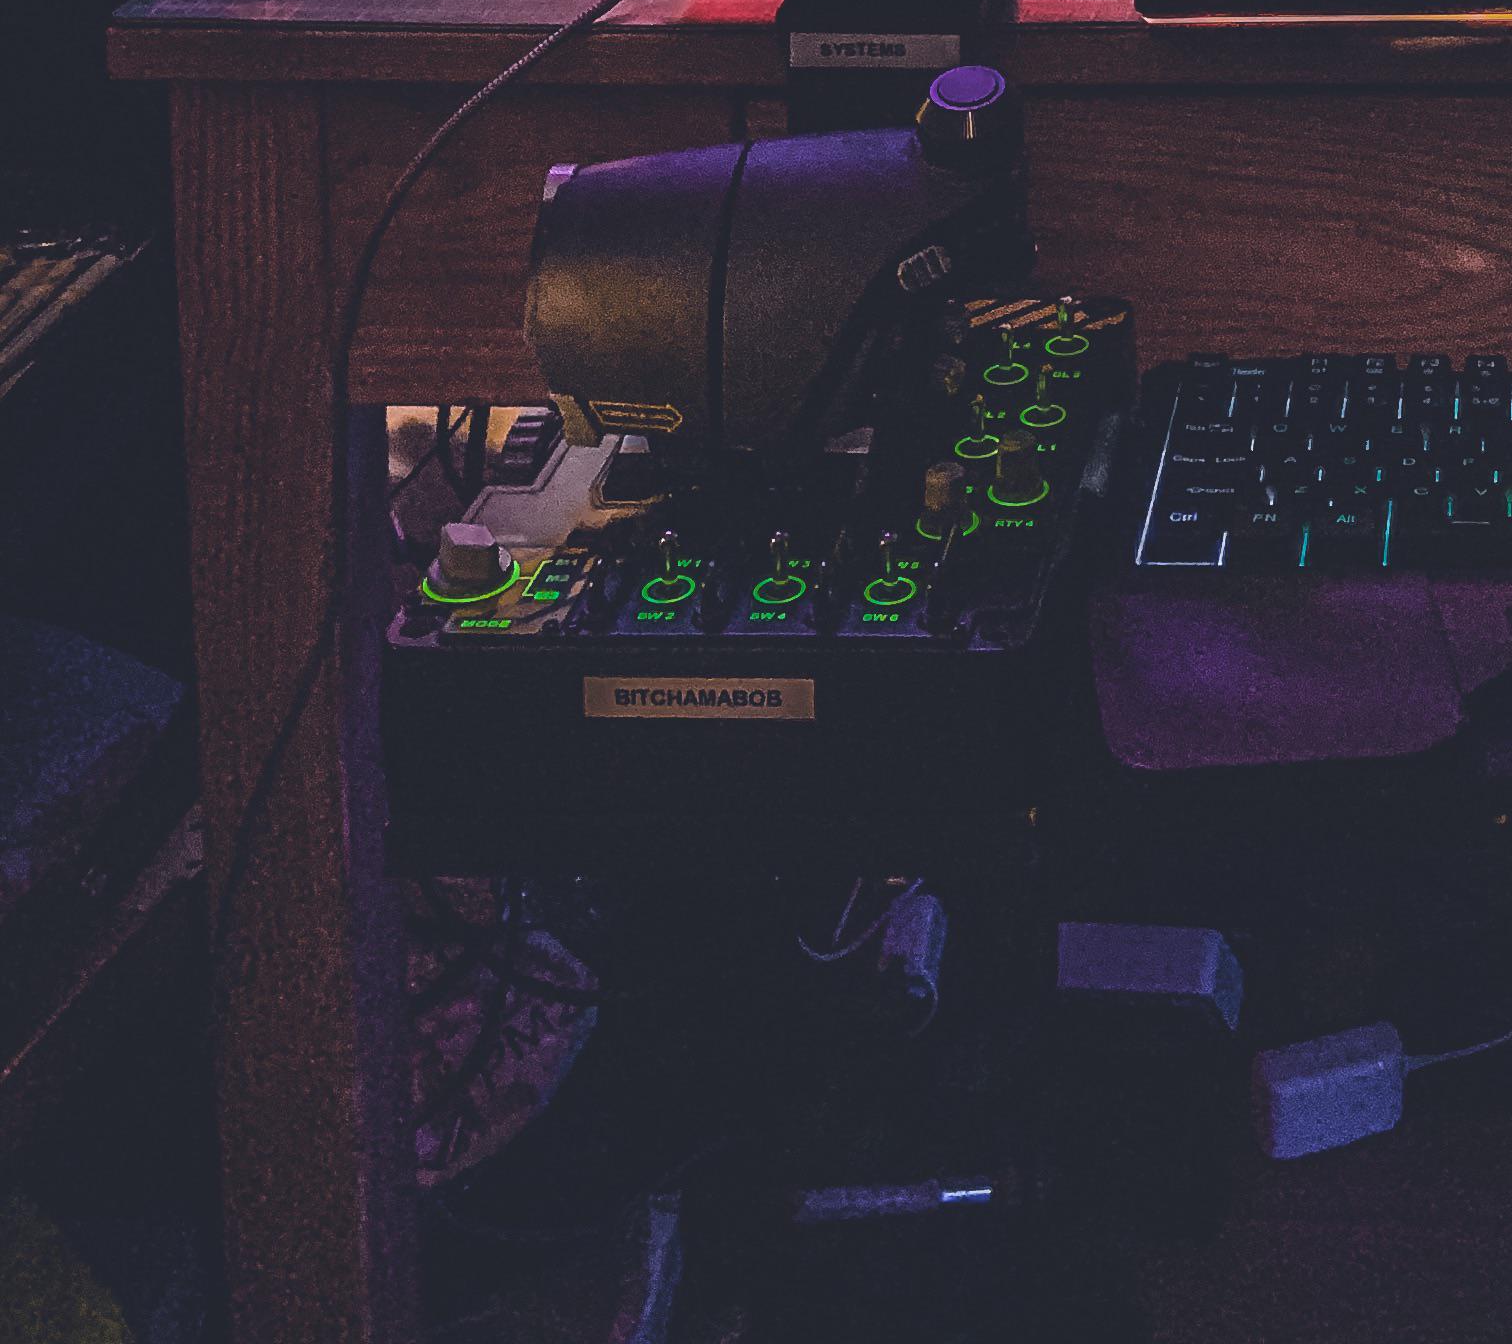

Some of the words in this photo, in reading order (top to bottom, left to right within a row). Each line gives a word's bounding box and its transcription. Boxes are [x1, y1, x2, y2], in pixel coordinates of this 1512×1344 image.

[819, 43, 907, 57] SYSTEMS
[1170, 512, 1198, 523] Ctrl
[461, 619, 513, 629] MODE
[613, 687, 784, 708] BITCHAMABOB
